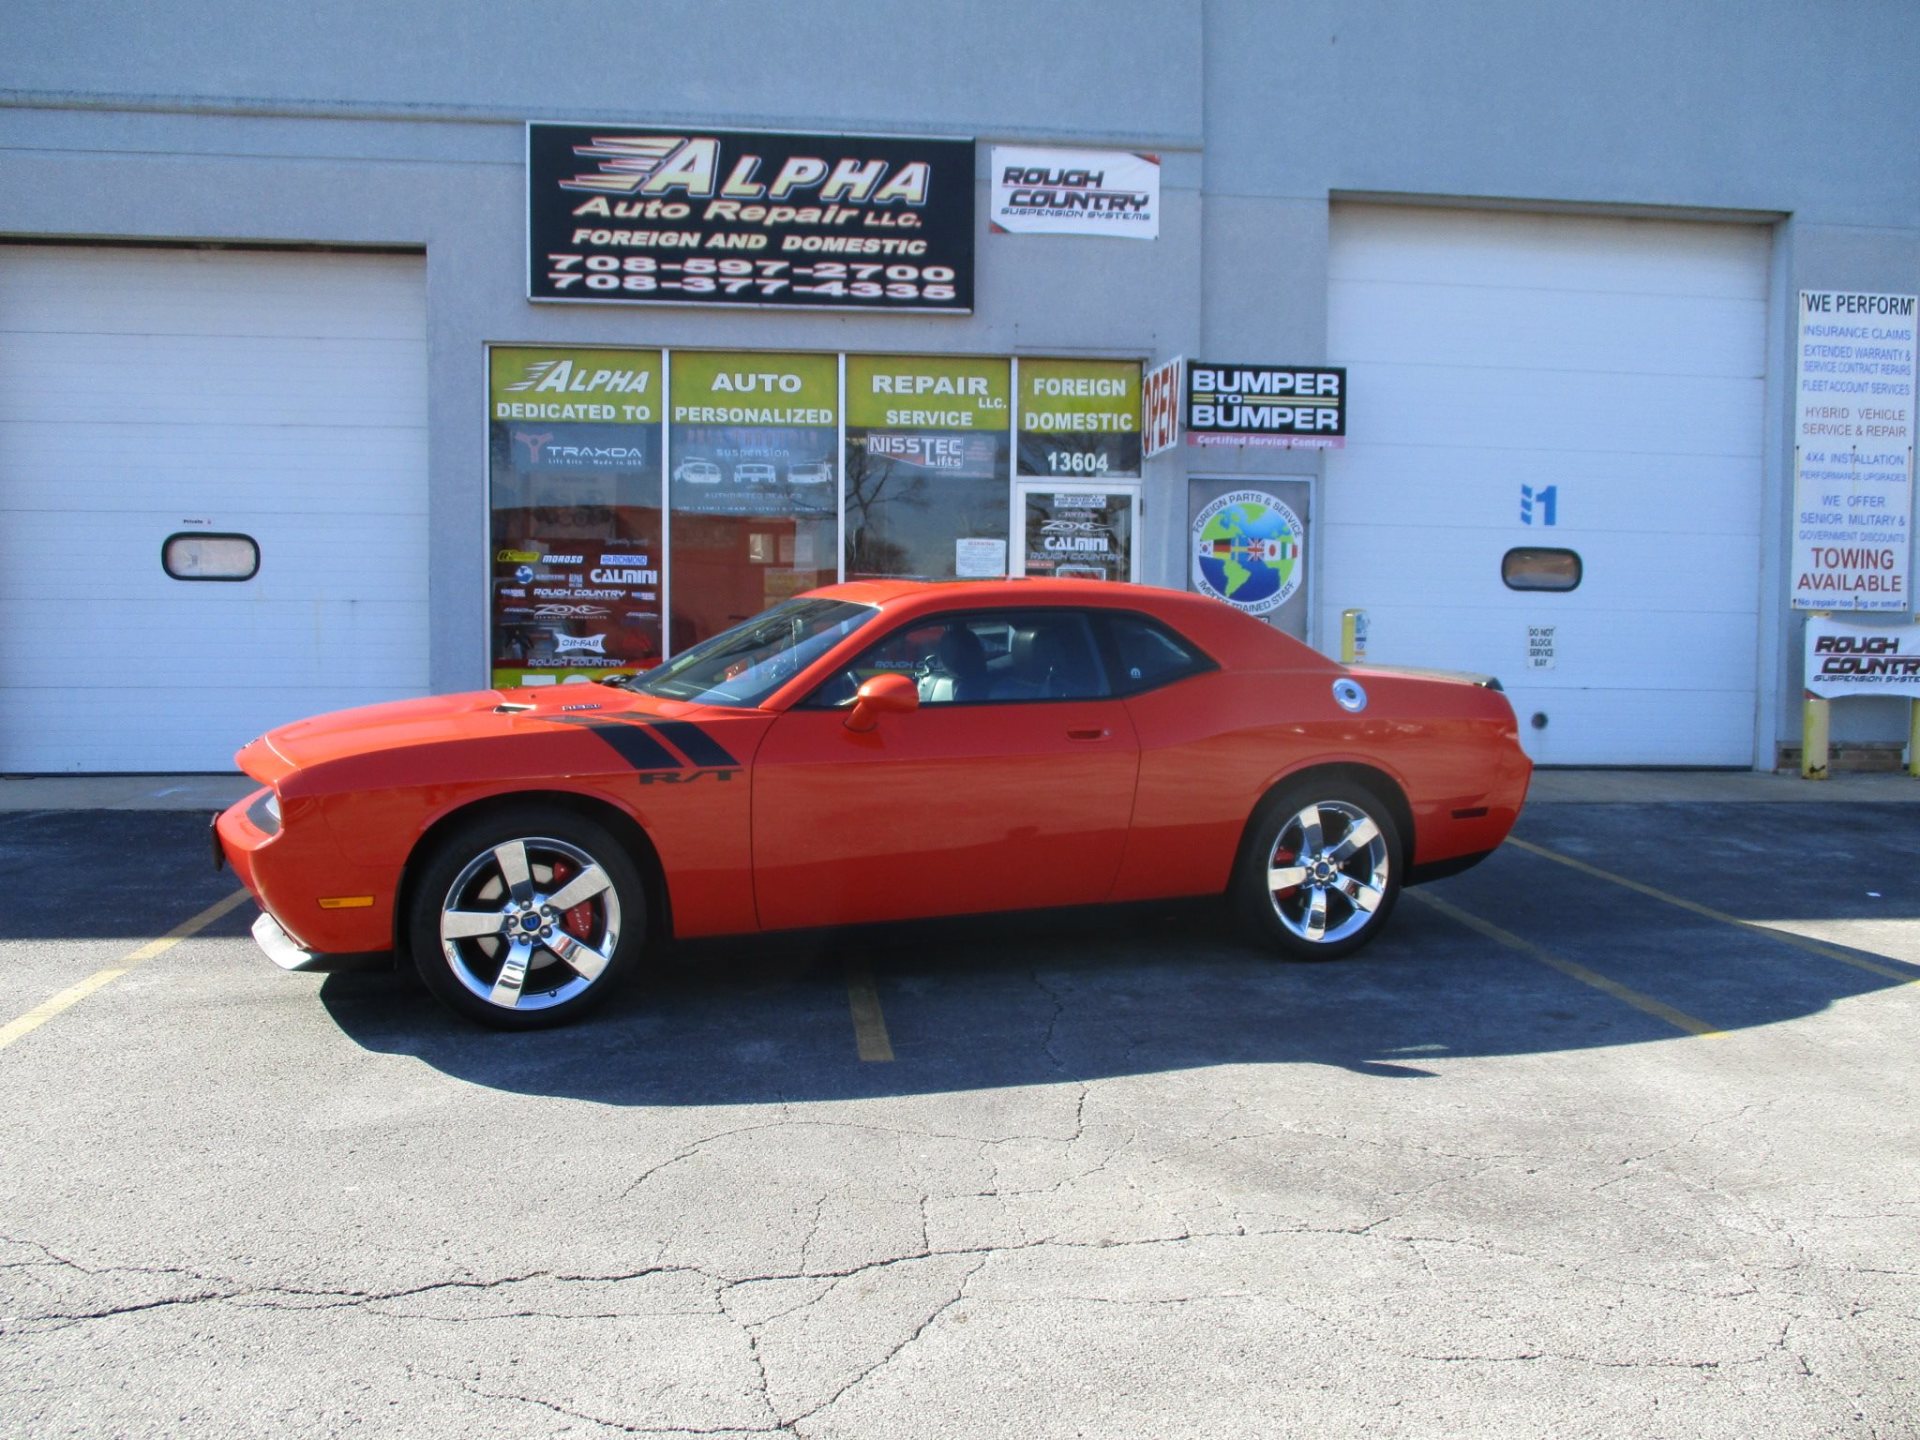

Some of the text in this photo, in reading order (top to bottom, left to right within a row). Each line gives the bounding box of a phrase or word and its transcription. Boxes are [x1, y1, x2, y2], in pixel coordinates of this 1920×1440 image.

[640, 138, 931, 205] ALPHA
[1002, 166, 1104, 188] ROUGH
[1009, 189, 1149, 212] COUNTRY
[572, 197, 922, 228] Auto Repair LLC.
[1000, 207, 1151, 221] SUSPENSION SYSTEMS
[572, 228, 928, 256] FOREIGN AND DOMESTIC
[548, 254, 956, 282] 708-597-2700
[548, 273, 956, 300] 708-377-4335
[1806, 294, 1912, 315] WE PERFORM
[1804, 325, 1911, 340] INSURANCE CLAIMS
[1804, 345, 1853, 357] EXTENDED
[1855, 347, 1902, 361] WARRANTY
[536, 360, 650, 393] ALPHA
[1803, 361, 1911, 375] SERVICE CONTRACT REPAIRS
[711, 373, 801, 393] AUTO
[872, 375, 988, 395] REPAIR
[1033, 378, 1126, 397] FOREIGN
[1192, 370, 1339, 395] BUMPER
[1802, 380, 1910, 395] FLEET ACCOUNT SERVICES
[978, 397, 1007, 409] LLC.
[1216, 394, 1242, 404] TO
[497, 402, 650, 420] DEDICATED TO
[675, 407, 833, 424] PERSONALIZED
[1142, 360, 1180, 457] OPEN
[1805, 407, 1905, 420] HYBRID VEHICLE
[886, 410, 973, 426] SERVICE
[1025, 412, 1133, 431] DOMESTIC
[1192, 405, 1339, 430] BUMPER
[1802, 423, 1906, 437] SERVICE & REPAIR
[1197, 435, 1246, 446] Certified
[1250, 436, 1290, 446] Service
[547, 446, 641, 457] TRAXDA
[1831, 453, 1904, 465] INSTALLATION
[1047, 452, 1109, 472] 13604
[1800, 471, 1906, 481] PERFORMANCE UPGRADES
[1822, 495, 1885, 507] WE OFFER
[1192, 499, 1227, 533] FOREIGN
[1228, 493, 1262, 503] PARTS
[1272, 503, 1303, 537] SERVICE
[1800, 513, 1842, 524] SENIOR
[1849, 515, 1896, 525] MILITARY
[1044, 537, 1108, 551] CALMINI
[1799, 531, 1905, 542] GOVERNMENT DISCOUNTS
[1070, 553, 1123, 561] COUNTRY
[1811, 548, 1894, 569] TOWING
[590, 569, 657, 584] CALMINI
[1798, 573, 1902, 592] AVAILABLE
[533, 588, 571, 597] ROUGH
[574, 589, 626, 598] COUNTRY
[1272, 581, 1294, 605] STAFF
[1812, 599, 1837, 607] repair
[1815, 636, 1899, 654] ROUGH
[527, 659, 626, 667] ROUGH COUNTRY
[1821, 657, 1920, 675] COUNTR
[639, 769, 744, 784] R/T
